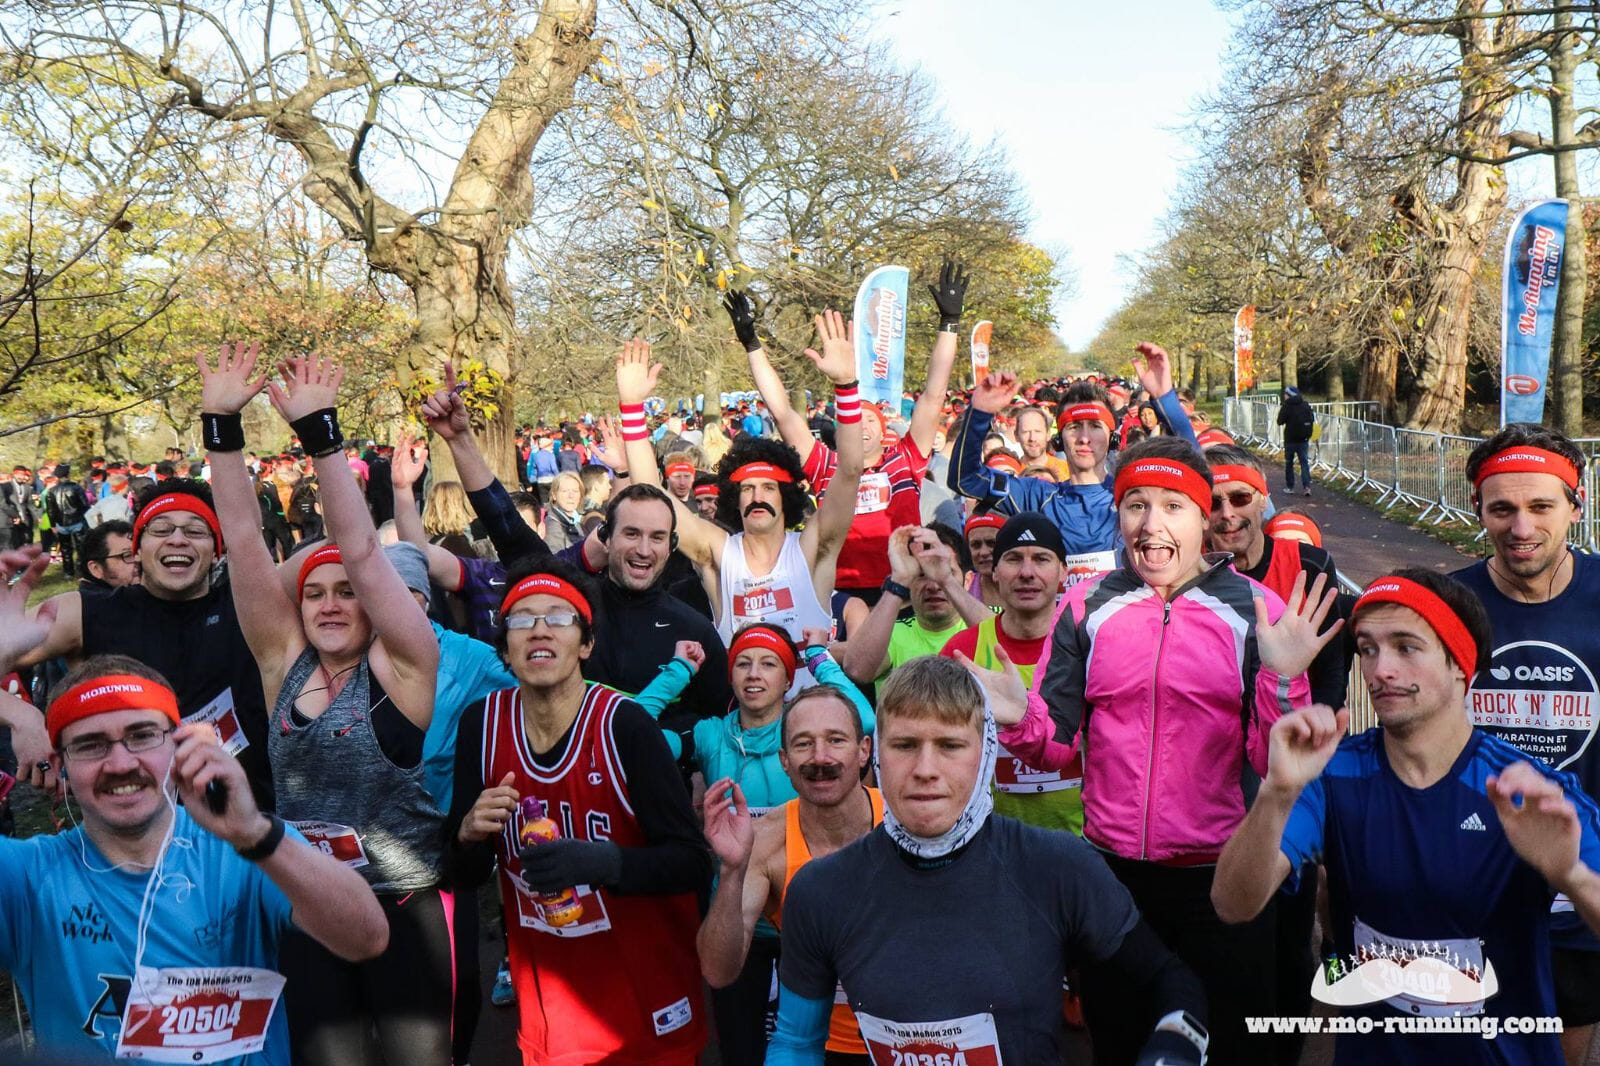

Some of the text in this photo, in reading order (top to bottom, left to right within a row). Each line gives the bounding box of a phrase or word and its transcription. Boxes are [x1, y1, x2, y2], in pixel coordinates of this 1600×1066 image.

[1497, 453, 1546, 463] MORUNNER
[1135, 464, 1183, 477] MORUNNER
[743, 591, 776, 610] 20714
[80, 684, 144, 703] MORUNNER
[1472, 692, 1518, 715] ROCK
[1553, 694, 1592, 717] ROLL
[1474, 715, 1591, 727] MONTRÉAL 2015
[1496, 732, 1568, 744] MARATHON ET
[62, 922, 114, 944] Work
[167, 975, 183, 985] The
[231, 974, 253, 984] 2015
[159, 1001, 242, 1034] 20504
[941, 1026, 962, 1036] 2015
